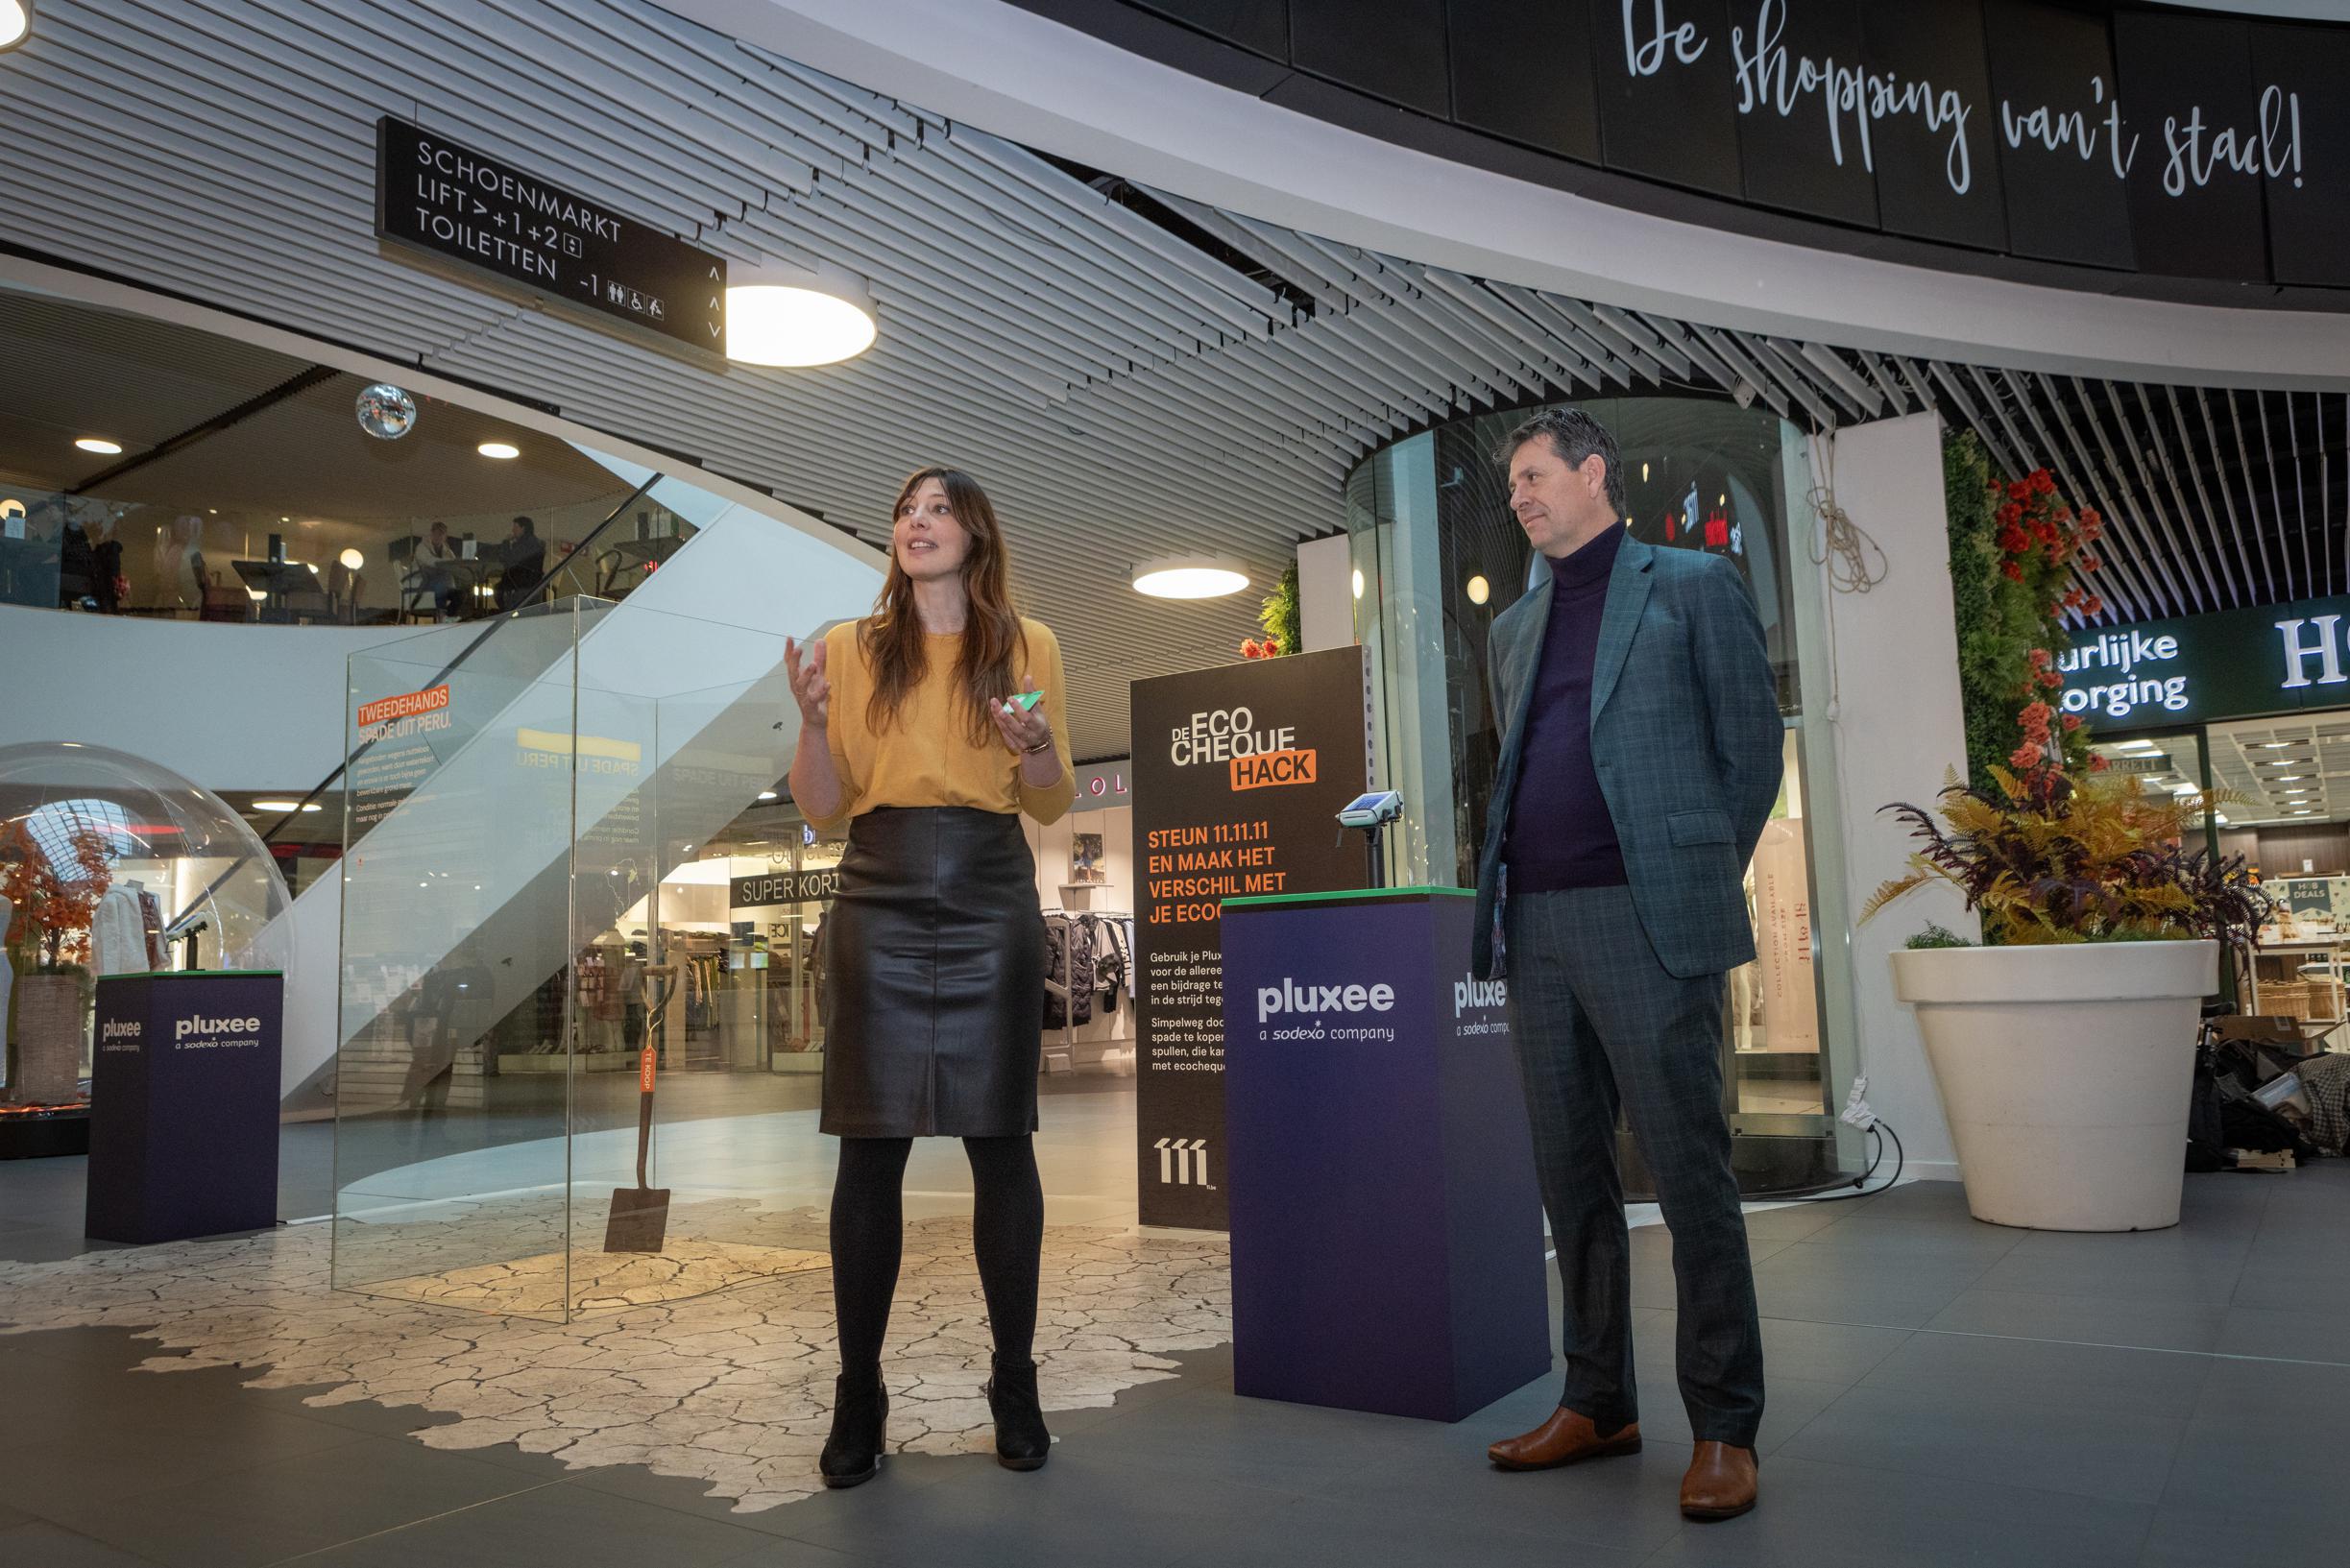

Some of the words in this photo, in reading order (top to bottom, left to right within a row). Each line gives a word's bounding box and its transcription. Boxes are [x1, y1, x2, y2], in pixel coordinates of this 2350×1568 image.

[1622, 0, 1708, 77] De
[1731, 0, 1972, 194] shopping
[2003, 76, 2139, 180] van't
[2163, 85, 2303, 196] stad!
[418, 141, 621, 243] SCHOENMARKT
[418, 174, 467, 211] LIFT
[416, 206, 557, 281] TOILETTEN
[580, 274, 598, 297] -1
[2274, 615, 2350, 688] H
[359, 689, 448, 723] TWEEDEHANDS
[2059, 674, 2189, 716] orging
[359, 723, 395, 744] SPADE
[397, 718, 416, 737] UIT
[417, 712, 452, 734] PERU.
[1172, 726, 1190, 742] DE
[1192, 706, 1253, 739] ECO
[1171, 726, 1296, 766] CHEQUE
[1236, 753, 1311, 785] HACK
[1148, 826, 1208, 849] STEUN
[1213, 821, 1269, 842] 11.11.11
[1149, 855, 1173, 874] EN
[1178, 850, 1233, 872] MAAK
[1238, 847, 1275, 866] HET
[742, 878, 794, 903] SUPER
[799, 873, 839, 897] KORT
[1150, 875, 1241, 899] VERSCHIL
[1246, 872, 1287, 893] MET
[2293, 889, 2325, 899] DEALS
[1150, 905, 1172, 923] JE
[1150, 952, 1188, 962] Gebruik
[1190, 951, 1199, 964] je
[1151, 968, 1172, 977] voor
[1174, 965, 1187, 976] de
[1189, 965, 1223, 976] alleree
[1151, 982, 1169, 991] een
[1171, 980, 1211, 993] bijdrage
[1151, 996, 1160, 1004] in
[1162, 994, 1175, 1004] de
[1177, 994, 1202, 1006] strijd
[1205, 995, 1223, 1006] teg
[1258, 977, 1394, 1023] pluxee
[1454, 972, 1507, 1018] pluxe
[103, 1018, 141, 1042] pluxee
[175, 1014, 260, 1040] pluxee
[1151, 1017, 1203, 1030] Simpelweg
[1259, 1029, 1267, 1041] a
[1272, 1025, 1325, 1041] sodexo
[1330, 1026, 1394, 1042] company
[1463, 1022, 1489, 1035] sodexo
[184, 1040, 218, 1049] sodexo
[221, 1039, 259, 1049] company
[1151, 1031, 1181, 1045] spade
[1184, 1032, 1194, 1042] te
[645, 1052, 651, 1062] TE
[1151, 1046, 1189, 1058] spullen,
[1192, 1046, 1207, 1056] die
[1152, 1061, 1172, 1071] met
[1174, 1060, 1225, 1073] ecochequ
